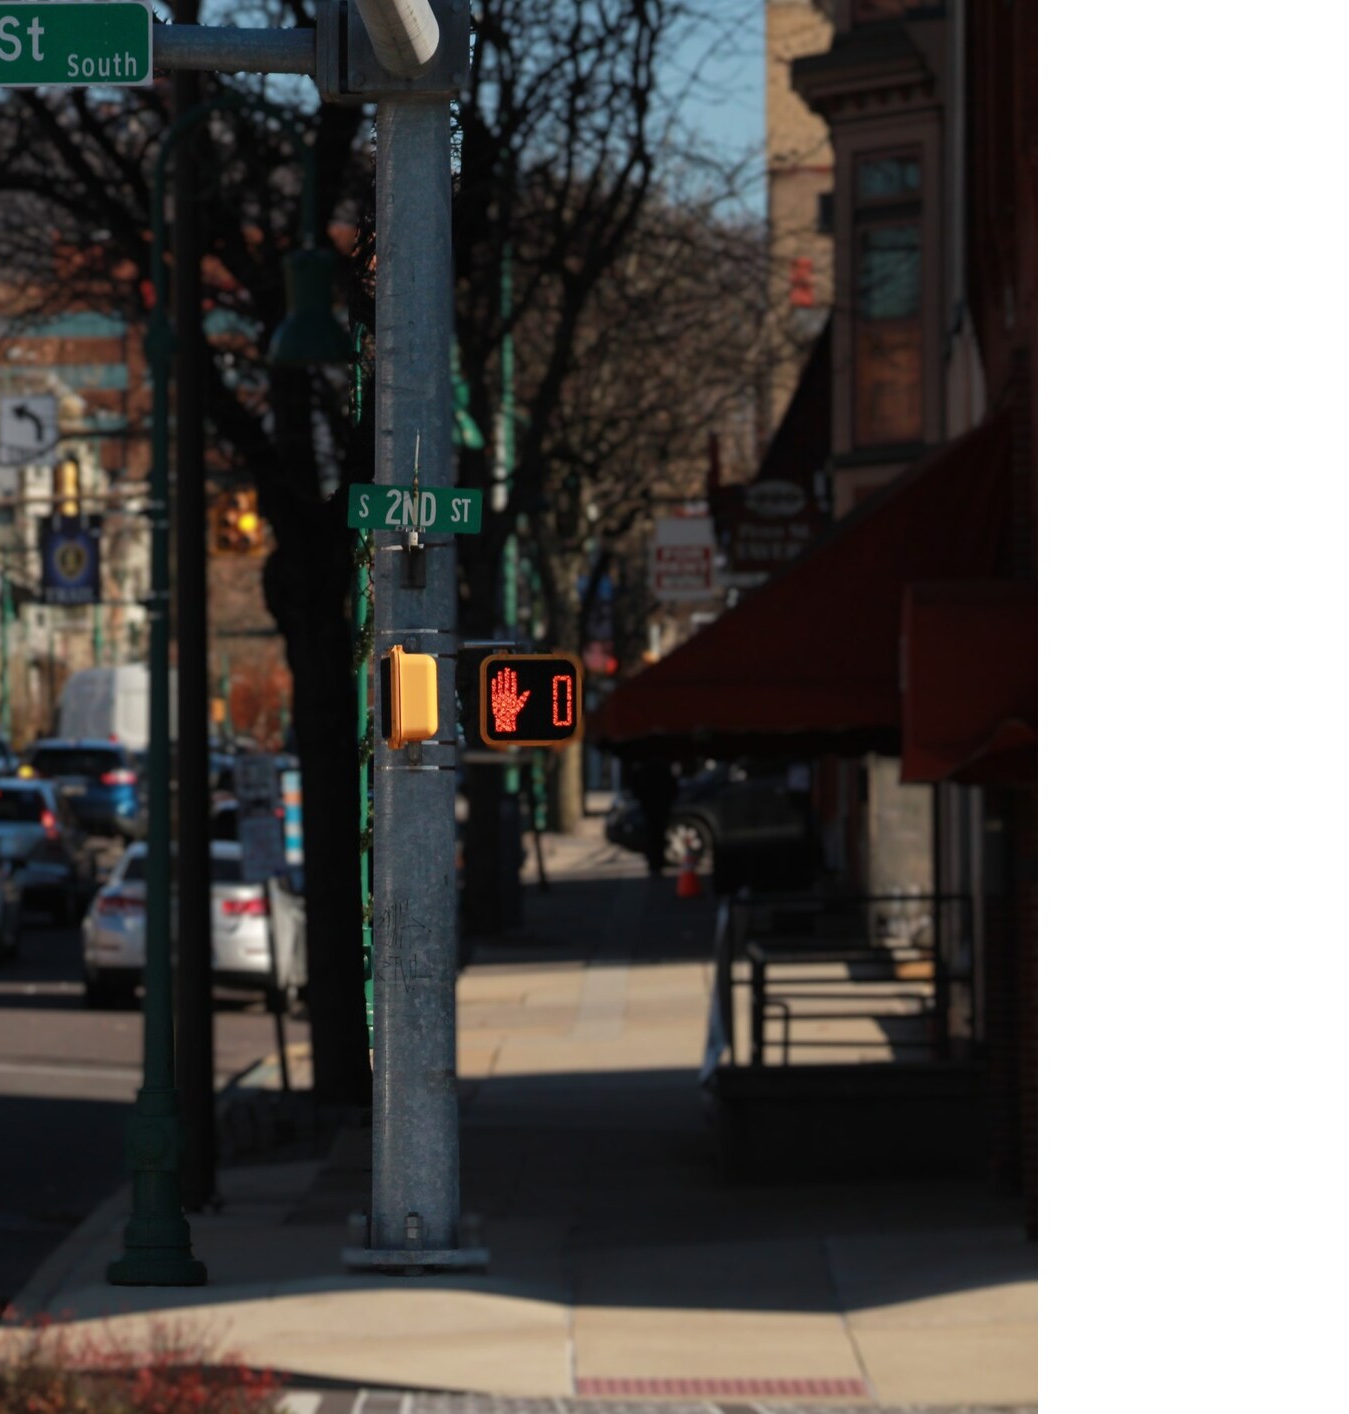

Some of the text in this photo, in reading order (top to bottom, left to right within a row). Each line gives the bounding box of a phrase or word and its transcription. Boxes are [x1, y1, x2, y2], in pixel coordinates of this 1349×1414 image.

[66, 51, 137, 78] South
[358, 488, 471, 527] S 2ND ST
[552, 675, 572, 727] 0
